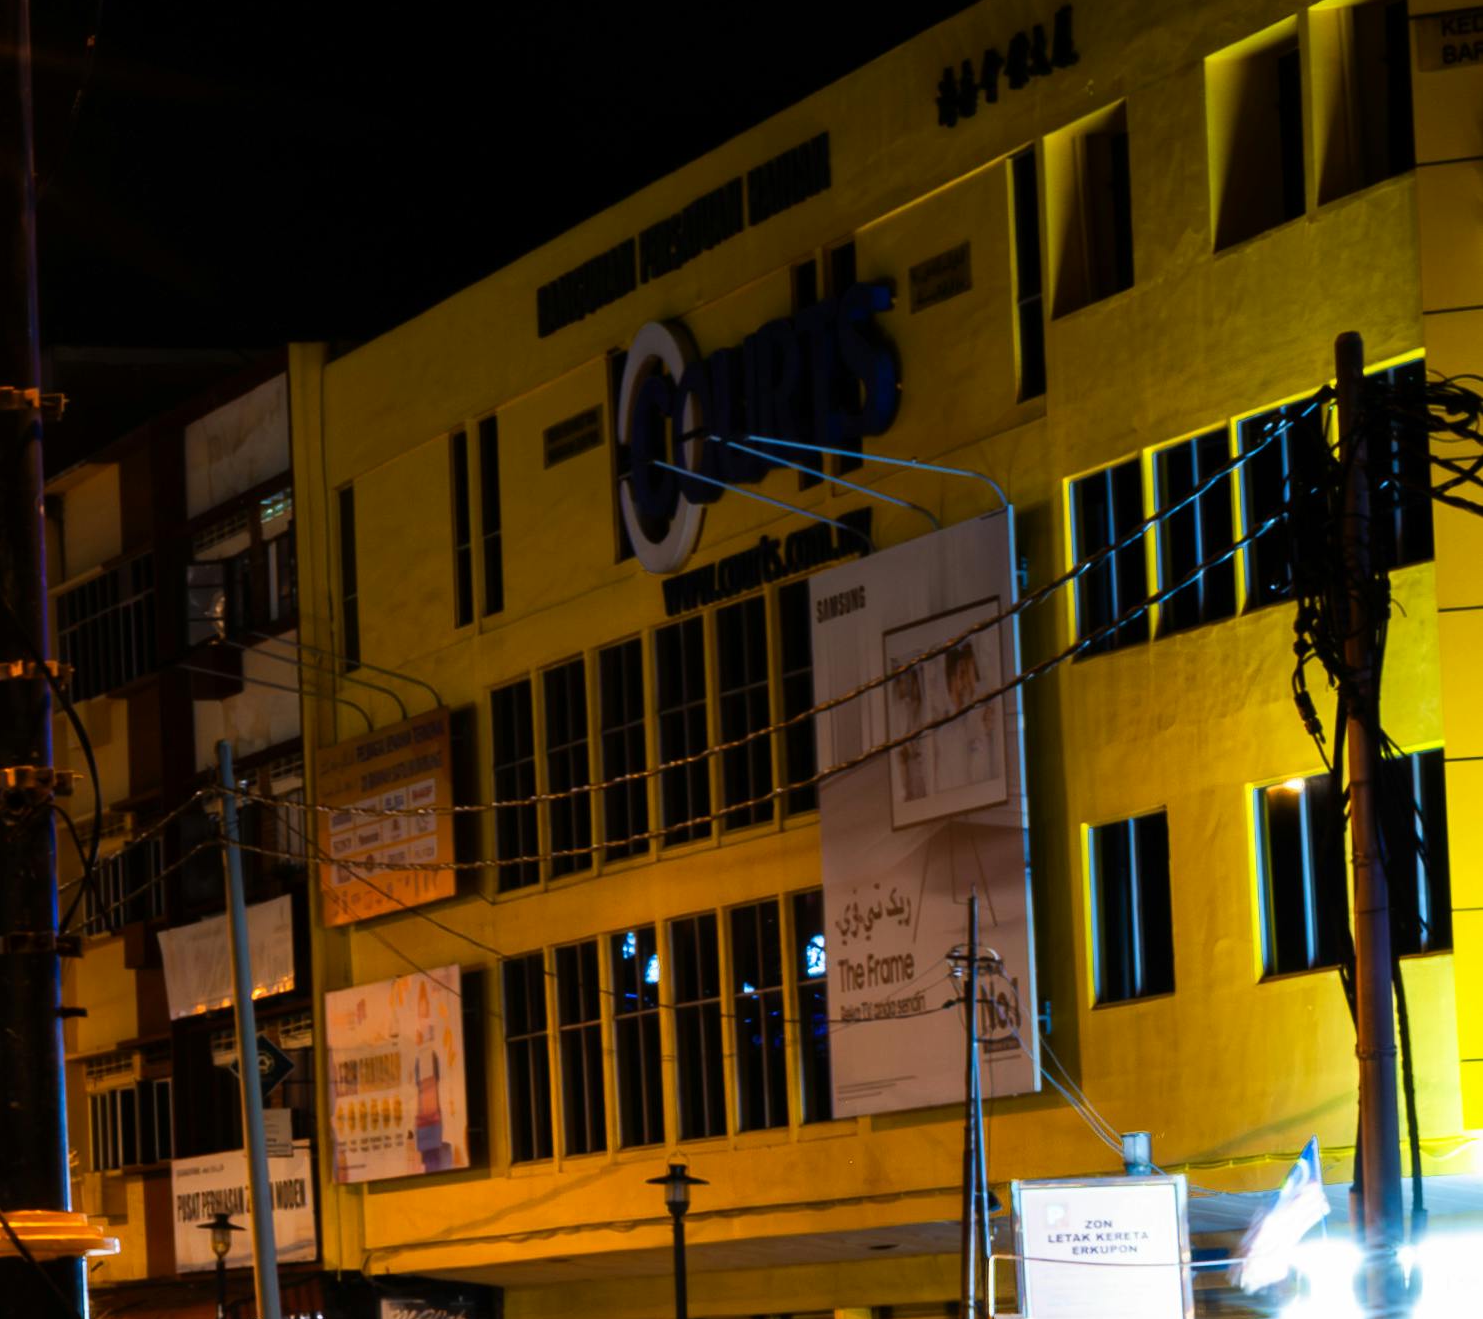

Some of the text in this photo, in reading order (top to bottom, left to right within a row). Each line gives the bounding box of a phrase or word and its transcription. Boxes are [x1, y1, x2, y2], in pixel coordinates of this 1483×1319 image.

[816, 585, 866, 623] SAMSUNG
[838, 950, 914, 993] The Frame
[1084, 1219, 1113, 1229] ZON
[1048, 1231, 1149, 1243] LETAK KERETA
